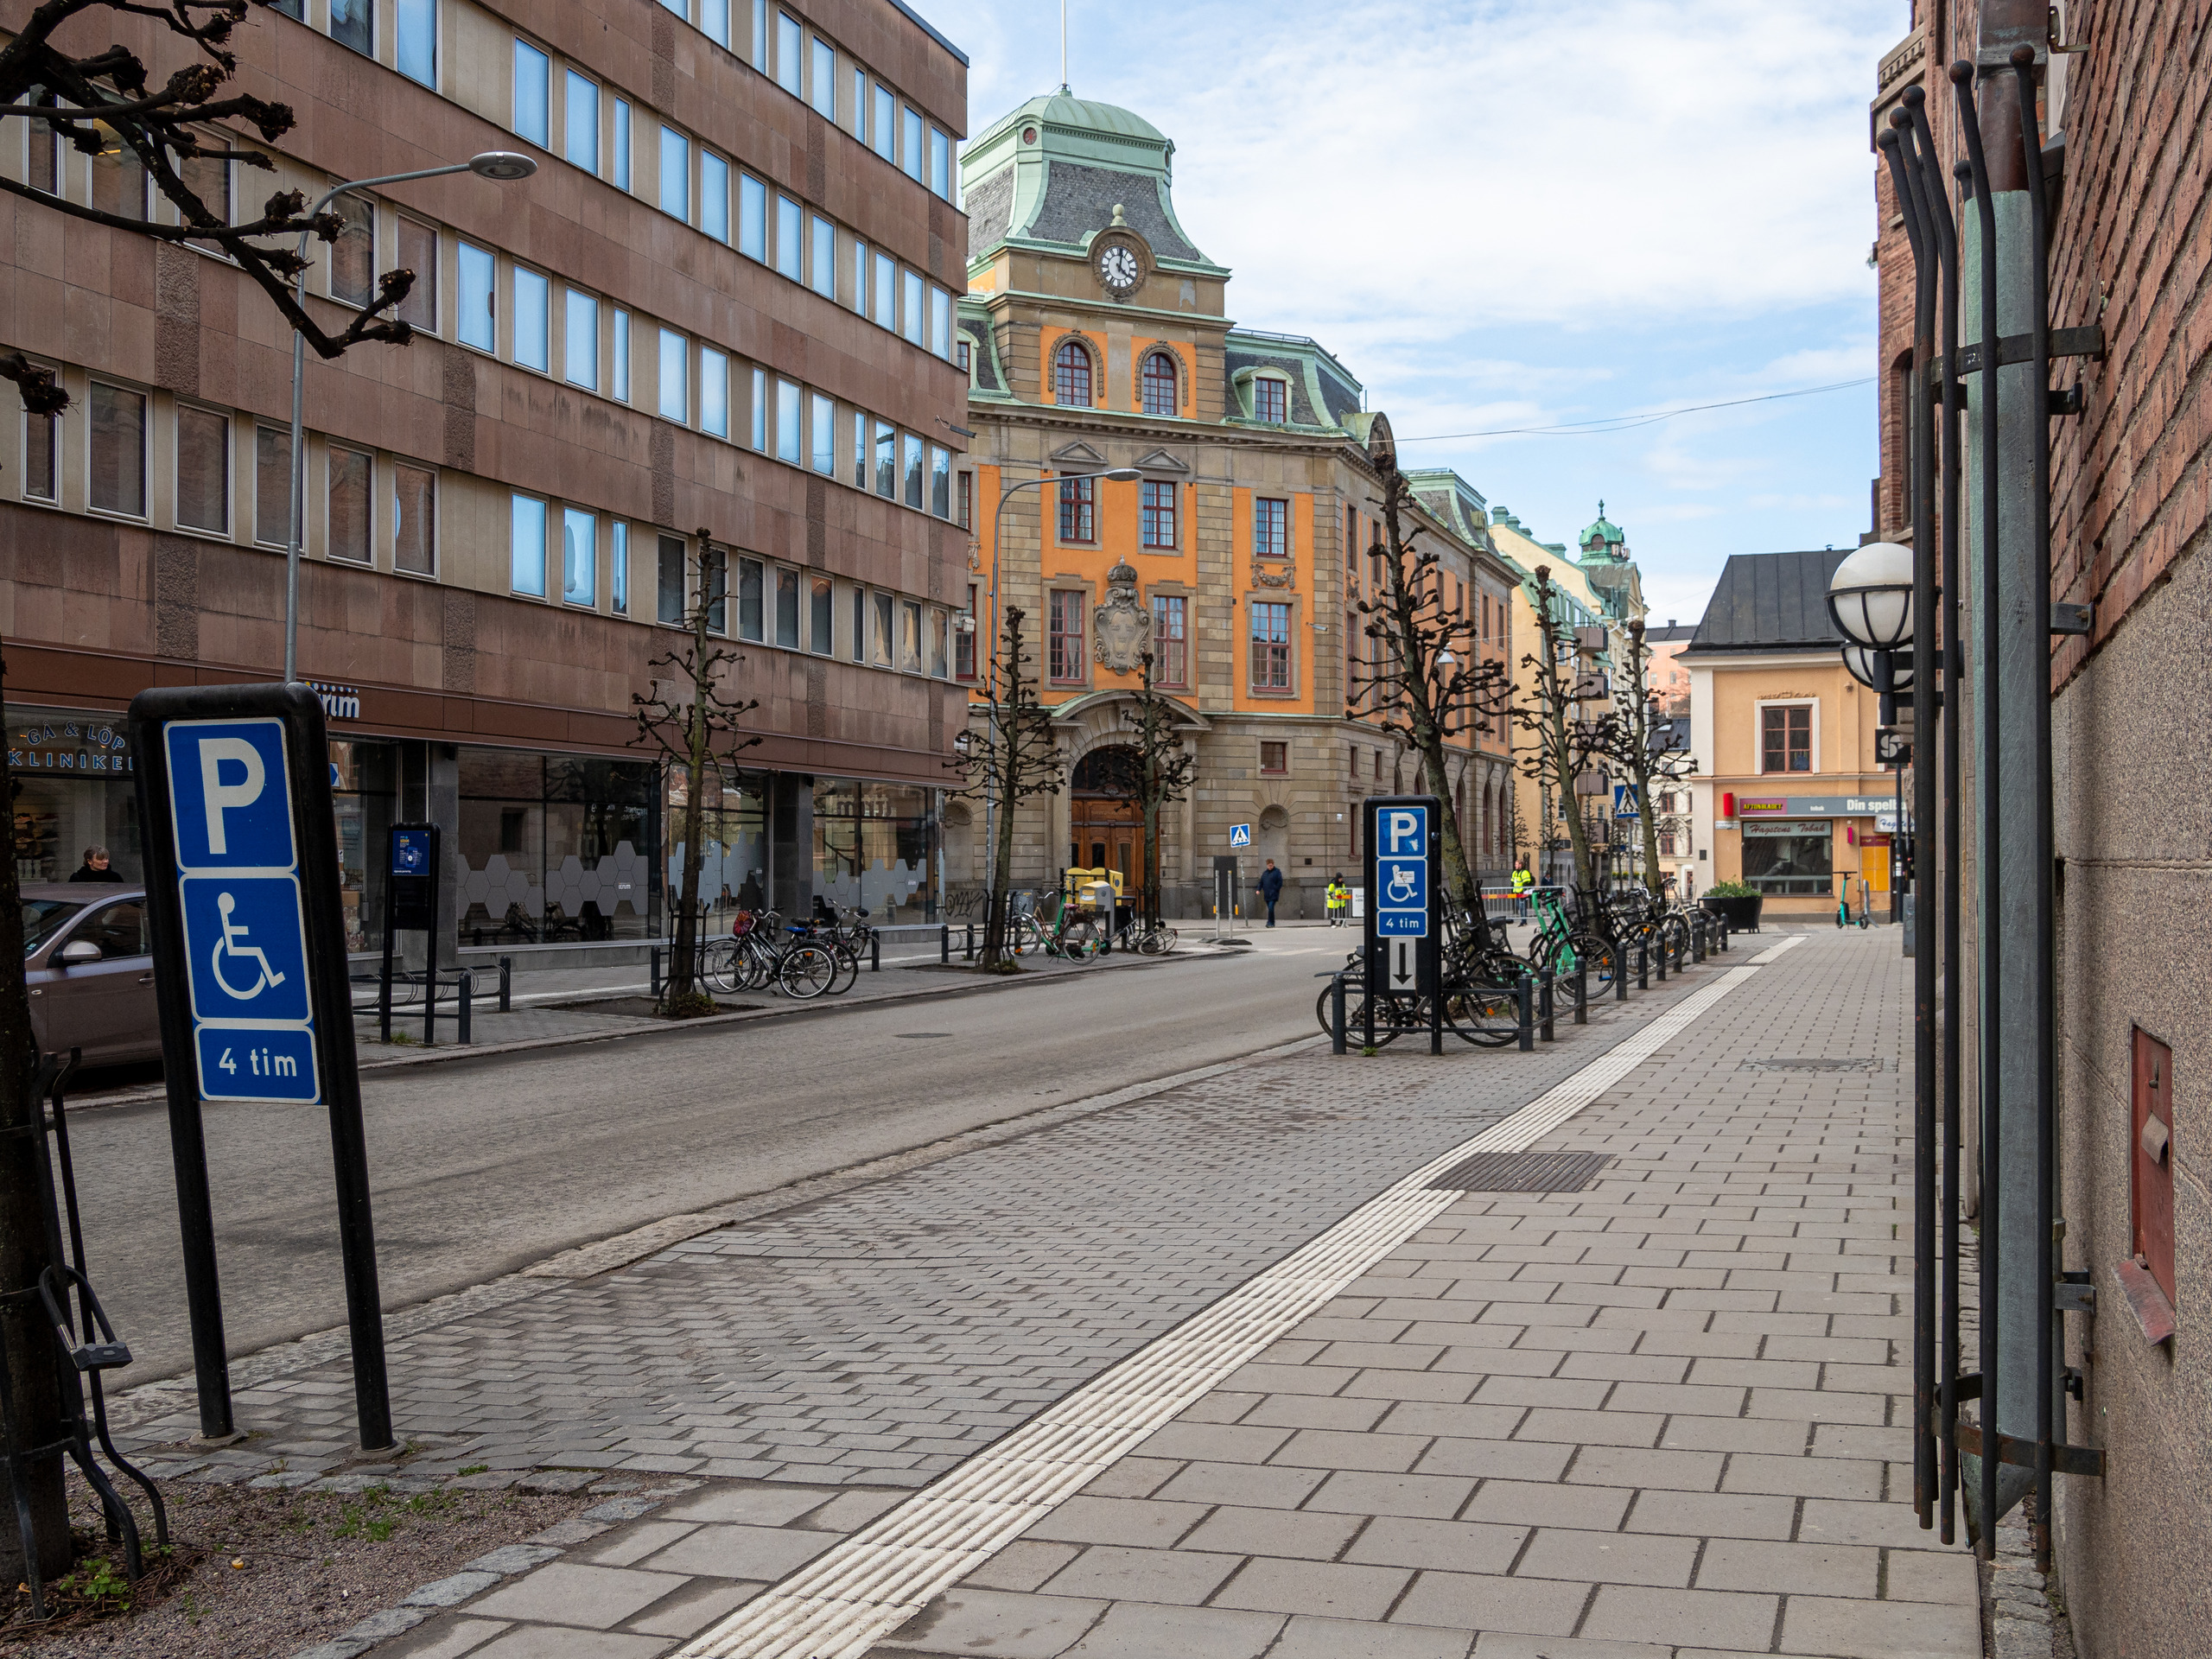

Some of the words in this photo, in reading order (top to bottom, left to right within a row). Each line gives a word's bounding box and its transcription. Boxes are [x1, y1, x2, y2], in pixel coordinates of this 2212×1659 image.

[27, 720, 56, 745] GÅ
[65, 721, 79, 737] &
[87, 724, 125, 750] LÖP
[199, 738, 265, 855] P
[1847, 799, 1866, 811] Din
[1390, 812, 1417, 853] P
[1749, 823, 1792, 835] Hagstens
[1797, 823, 1826, 833] Tobak
[1386, 918, 1394, 928] 4
[1399, 918, 1419, 928] tim
[219, 1047, 237, 1075] 4
[250, 1048, 297, 1077] tim
